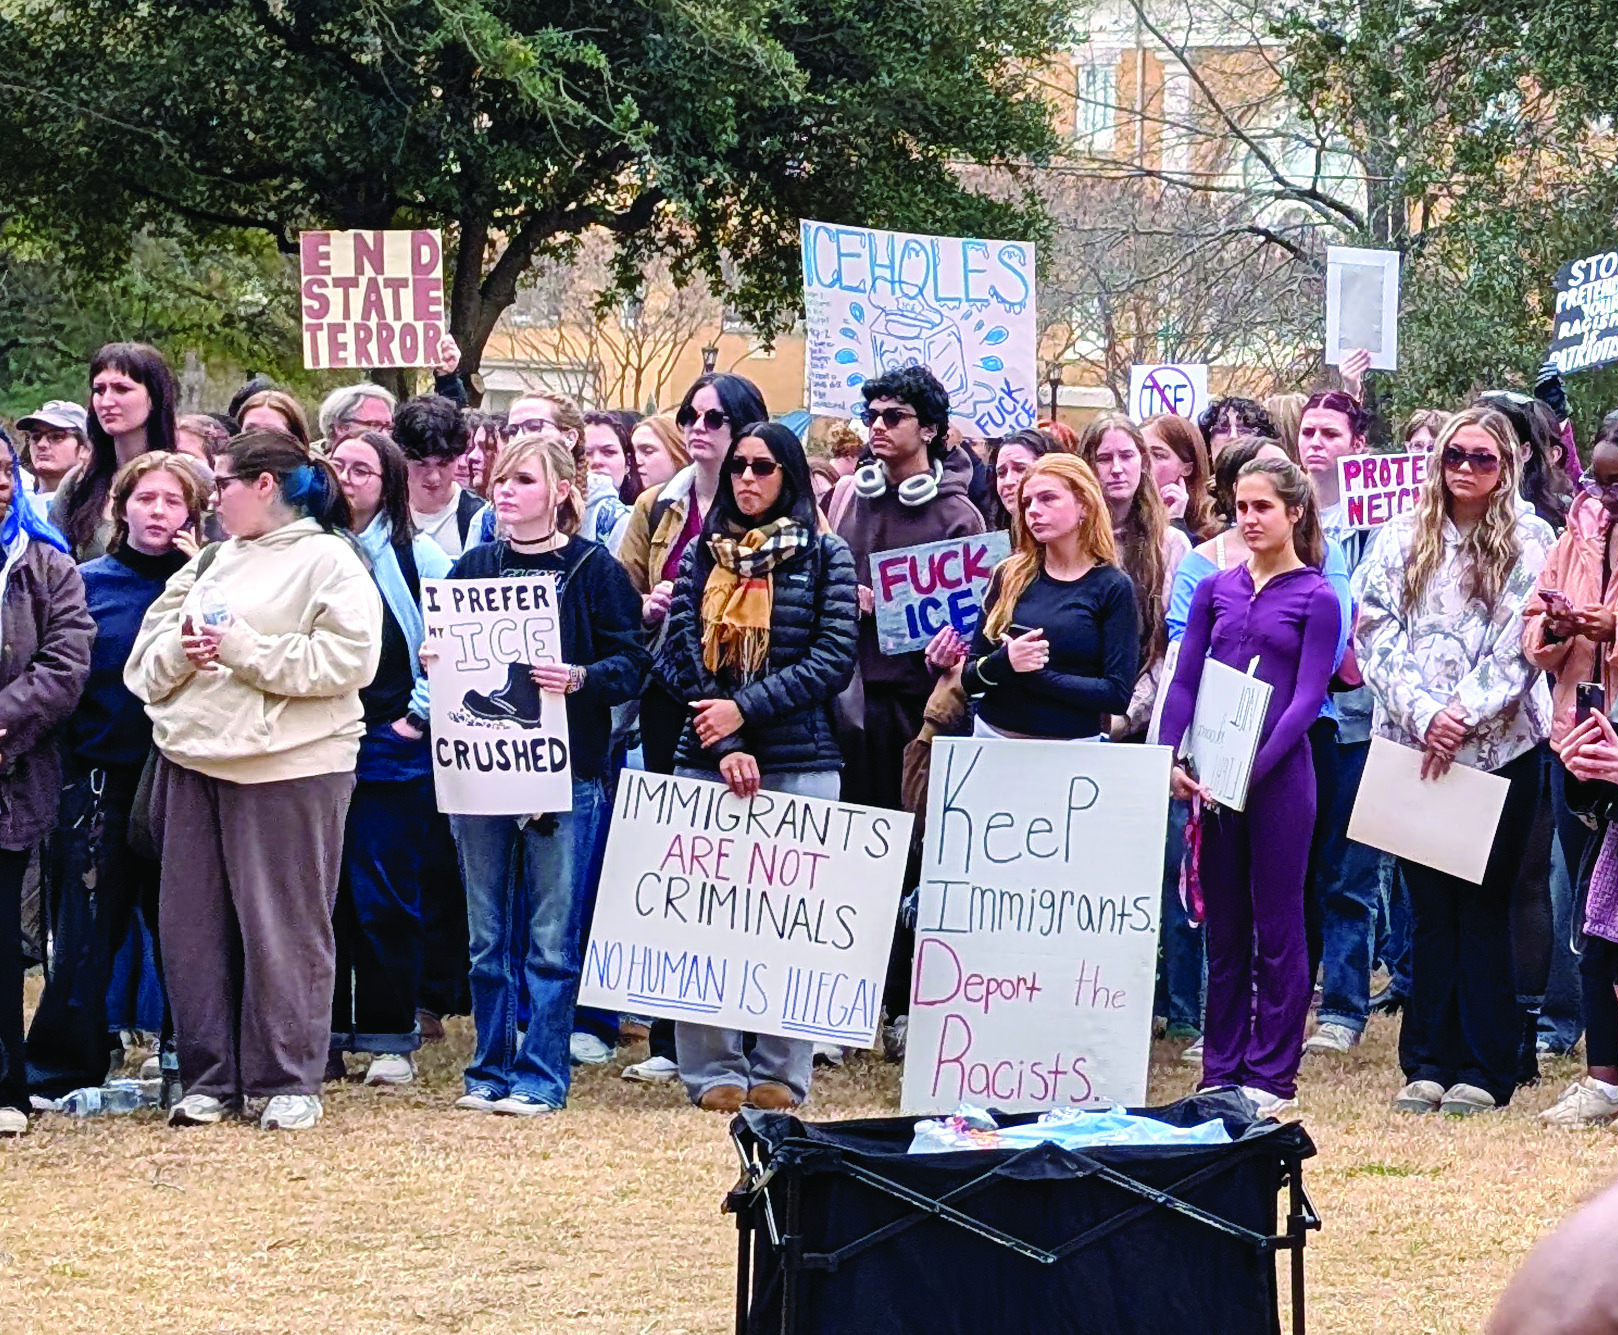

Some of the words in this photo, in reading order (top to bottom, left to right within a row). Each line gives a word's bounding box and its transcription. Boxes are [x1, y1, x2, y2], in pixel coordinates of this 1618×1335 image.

[302, 232, 440, 277] END
[304, 276, 443, 322] STATE
[305, 322, 442, 368] TERROR
[975, 377, 1025, 437] FUCK
[1343, 454, 1430, 492] PROTE
[425, 586, 441, 612] I
[452, 585, 550, 613] PREFER
[878, 543, 992, 602] FUCK
[905, 587, 981, 640] ICE
[428, 625, 444, 639] MY
[449, 617, 555, 672] ICE
[435, 737, 568, 773] CRUSHED
[622, 774, 892, 859] IMMIGRANTS
[660, 834, 734, 882] ARE
[748, 842, 830, 890] NOT
[635, 872, 857, 950] CRIMINALS
[584, 939, 623, 991] NO
[627, 944, 727, 1003] HUMAN
[739, 959, 768, 1015] IS
[782, 965, 877, 1029] ILLEGAL
[914, 938, 1043, 1015] Deport
[1075, 959, 1126, 1009] the
